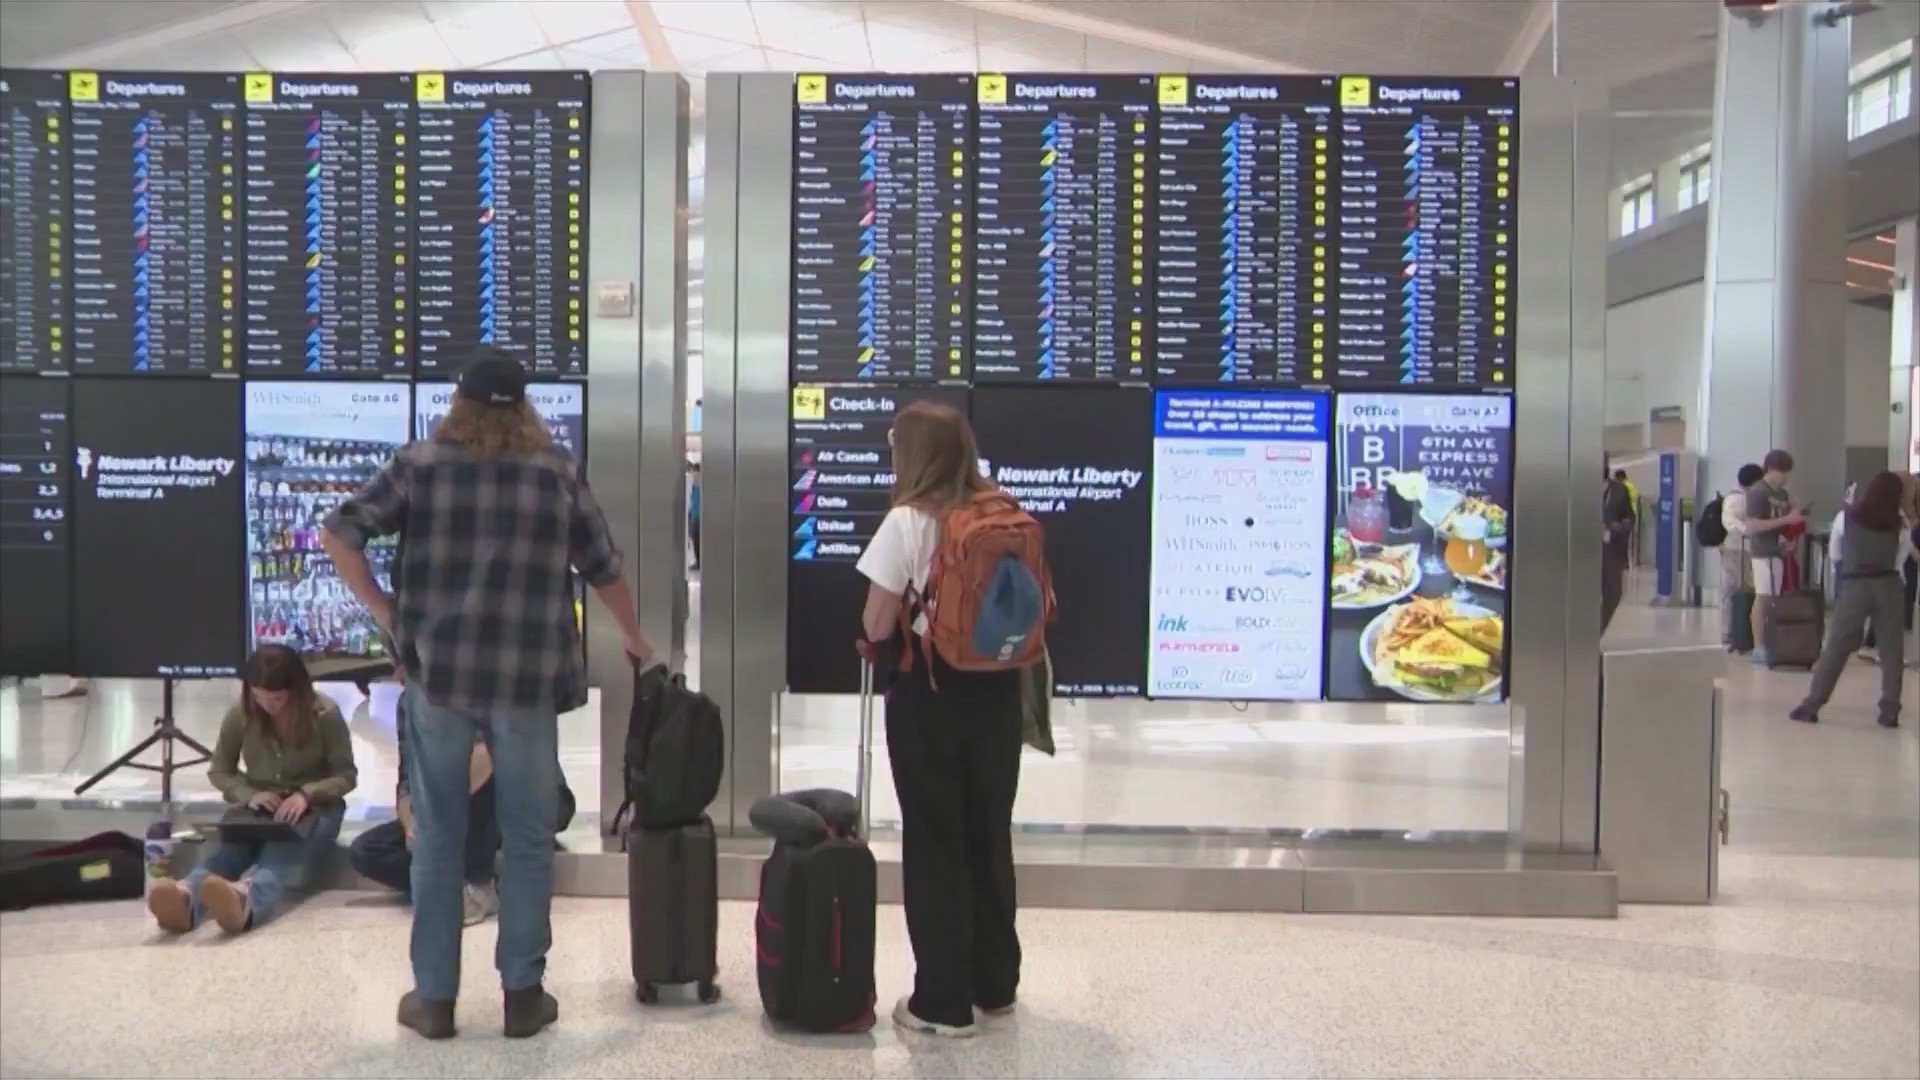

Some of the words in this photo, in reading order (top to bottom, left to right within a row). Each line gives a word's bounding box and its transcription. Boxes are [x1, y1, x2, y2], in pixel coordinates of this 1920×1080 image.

[107, 81, 185, 96] Departures
[281, 82, 358, 97] Departures
[453, 82, 531, 96] Departures
[835, 83, 915, 99] Departures
[1015, 84, 1096, 99] Departures
[1196, 85, 1278, 100] Departures
[1379, 85, 1461, 102] Departures
[829, 397, 895, 411] Check-in
[1353, 405, 1400, 417] Office
[1363, 435, 1384, 463] B
[1461, 437, 1496, 449] AVE
[817, 451, 834, 462] Air
[836, 451, 879, 463] Canada
[1419, 451, 1499, 463] EXPRESS
[97, 455, 167, 472] Newark
[170, 455, 235, 476] Liberty
[1460, 466, 1495, 478] AVE
[97, 474, 175, 486] International
[176, 474, 216, 488] Airport
[817, 473, 871, 484] American
[997, 466, 1070, 483] Newark
[1072, 466, 1143, 488] Liberty
[97, 487, 152, 499] Terminal
[153, 488, 164, 499] A
[1079, 486, 1123, 501] Airport
[817, 496, 848, 507] Delta
[1055, 500, 1066, 512] A
[817, 520, 855, 532] United
[1157, 613, 1189, 632] ink
